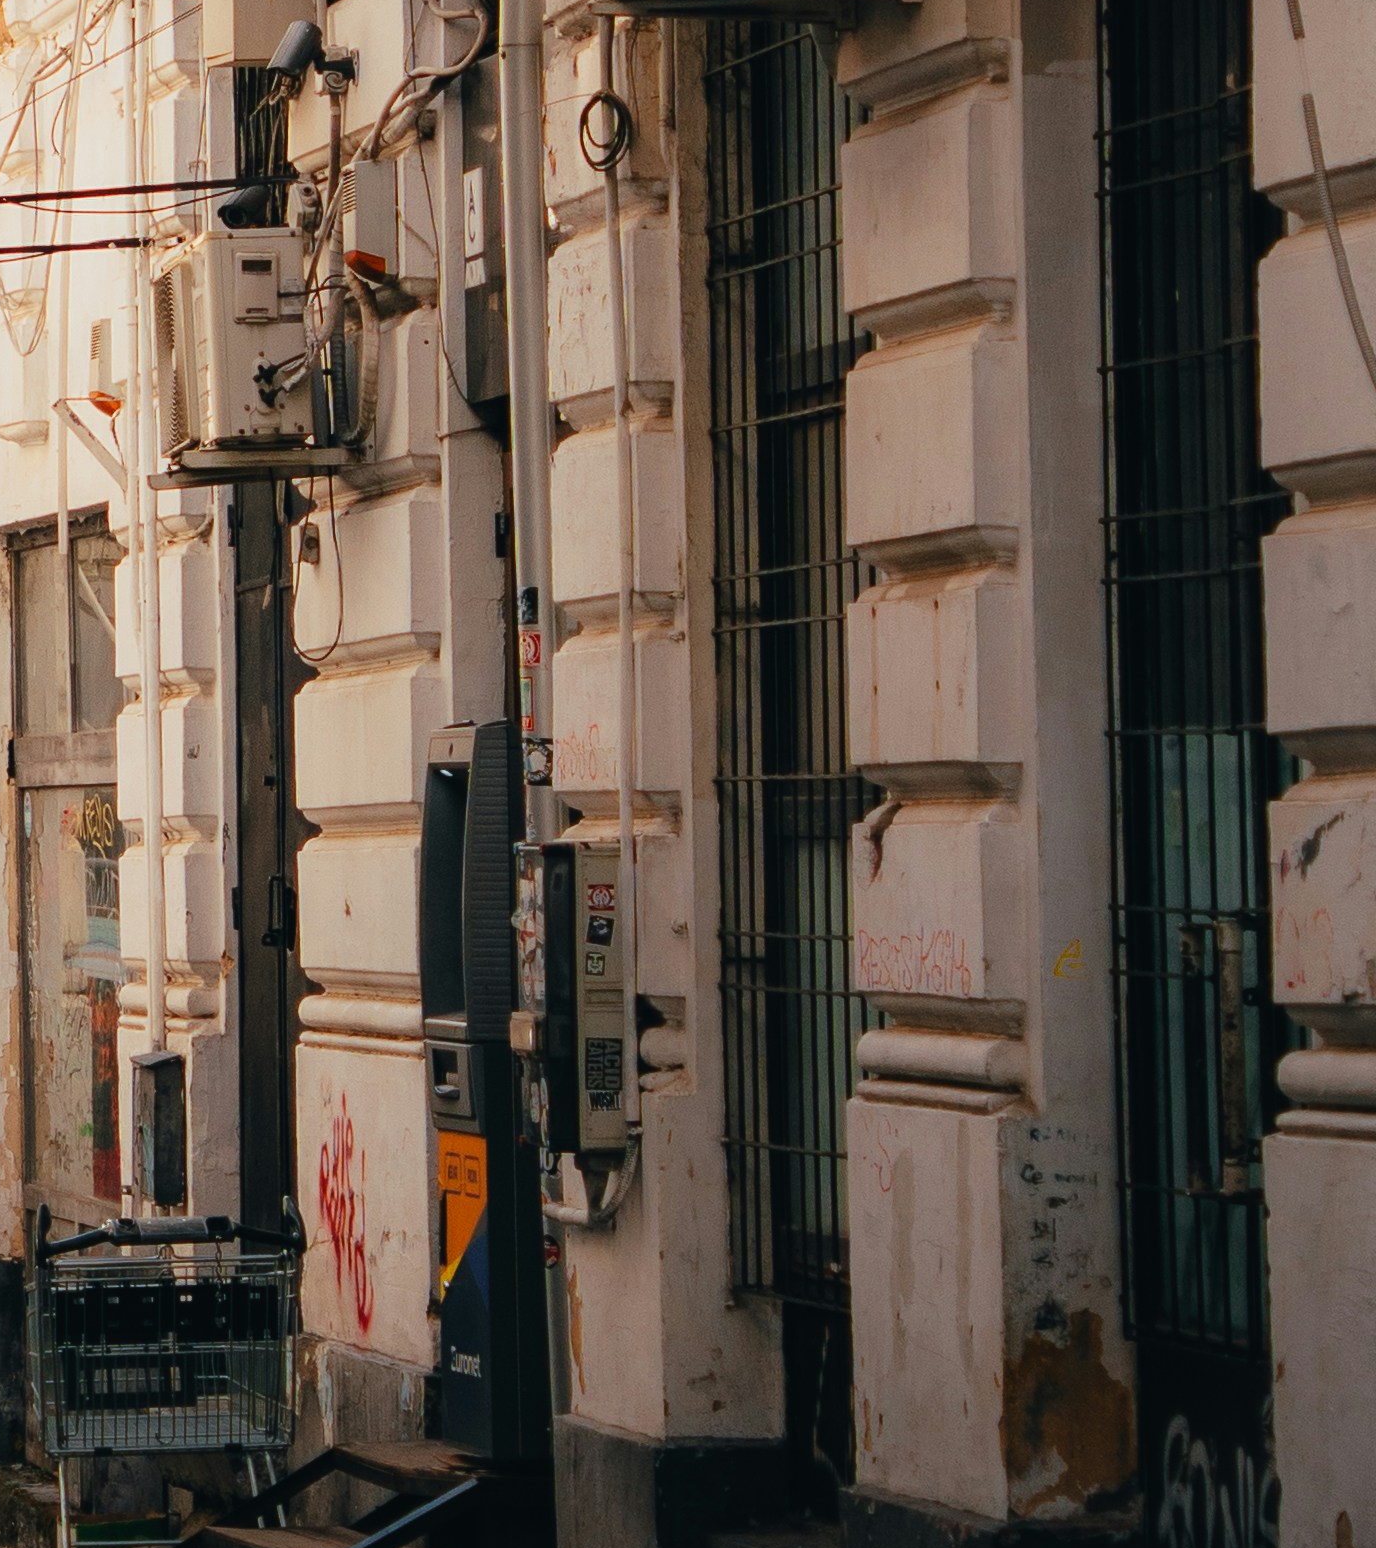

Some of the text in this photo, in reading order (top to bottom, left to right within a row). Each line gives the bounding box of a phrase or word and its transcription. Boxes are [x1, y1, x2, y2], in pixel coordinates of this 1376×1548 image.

[587, 1039, 604, 1088] EATERS
[604, 1039, 621, 1089] ACID
[450, 1345, 483, 1379] Euronet
